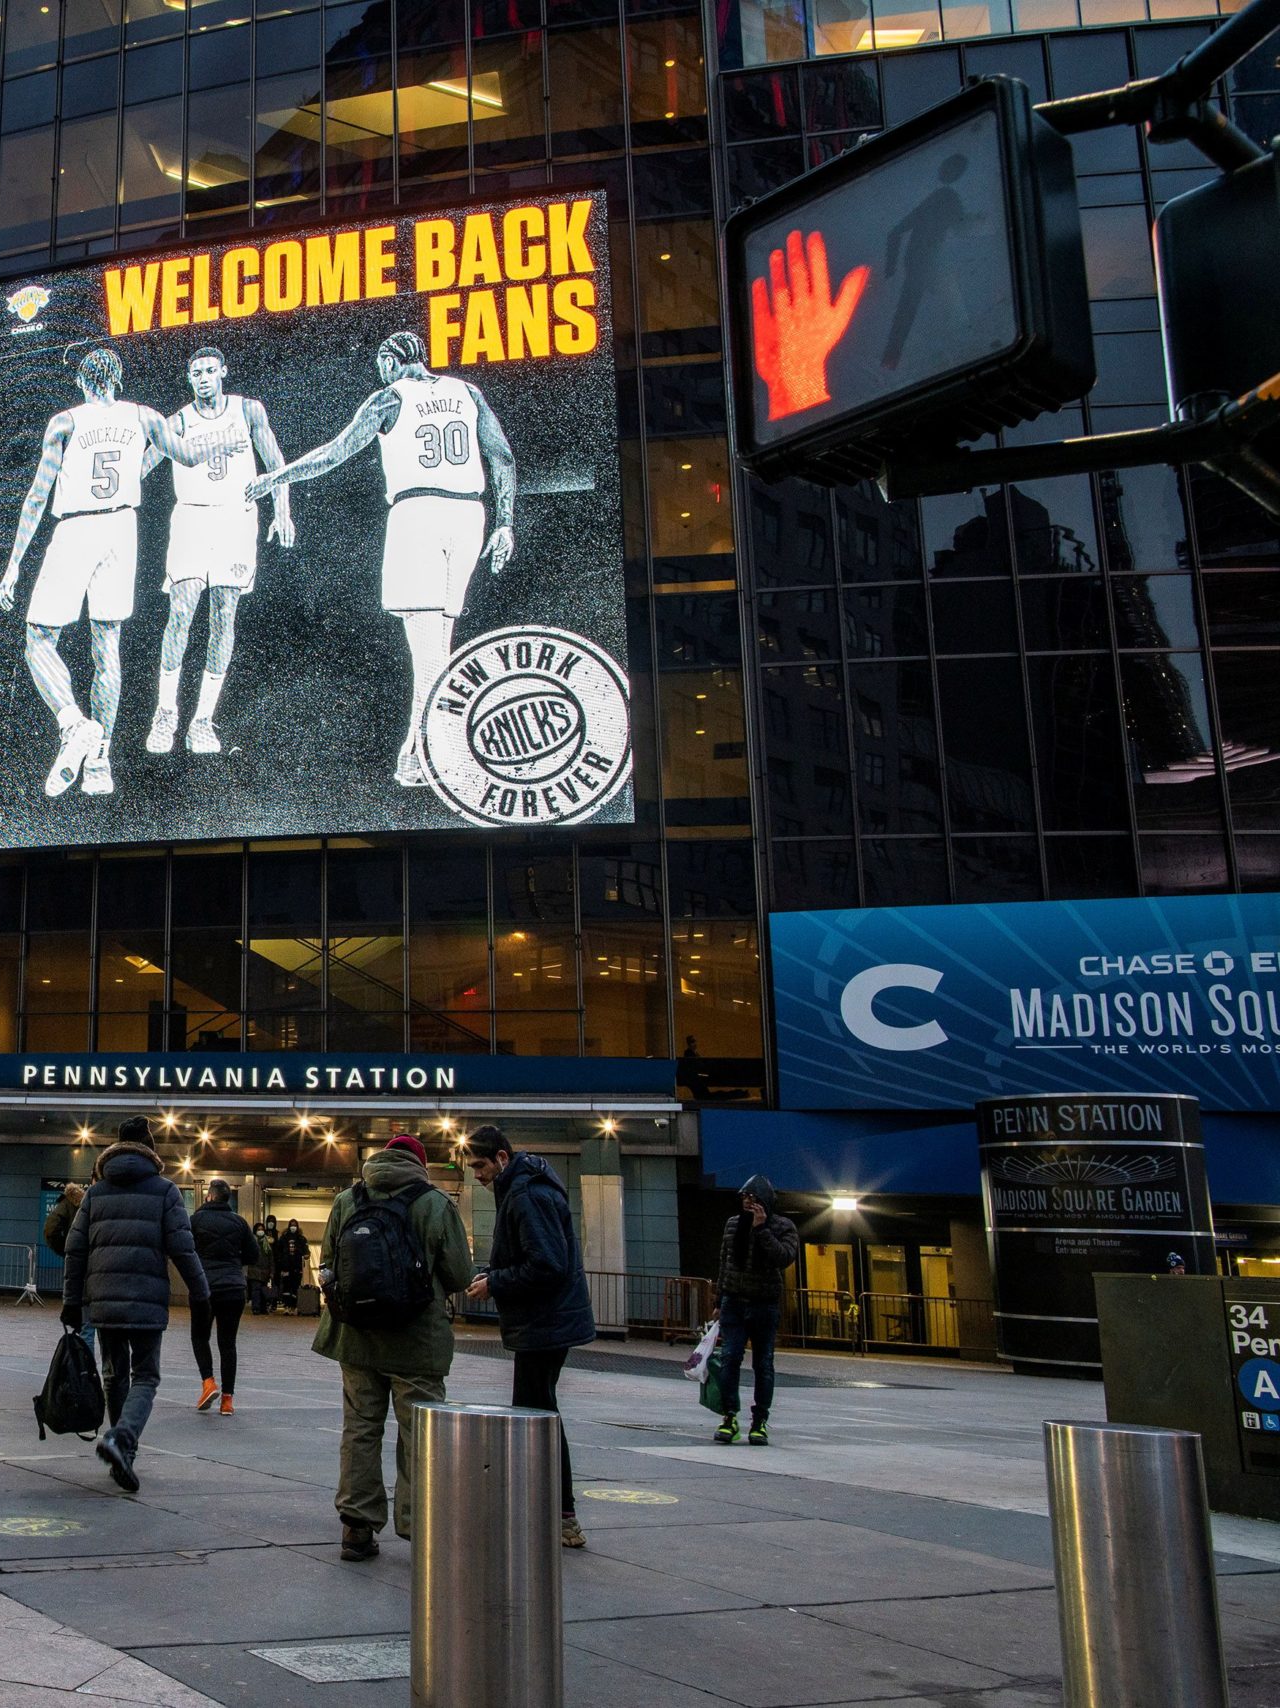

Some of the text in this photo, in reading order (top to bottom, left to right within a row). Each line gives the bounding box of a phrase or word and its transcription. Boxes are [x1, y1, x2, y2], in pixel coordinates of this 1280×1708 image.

[104, 199, 595, 336] WELCOME BACK
[429, 278, 597, 369] FANS
[415, 398, 463, 418] RANDLE
[78, 426, 137, 450] QUICKLEY
[414, 420, 470, 469] 30
[91, 450, 121, 500] 5
[436, 641, 583, 717] NEW YORK
[479, 700, 573, 758] KNICKS
[478, 749, 614, 818] FOREVER
[1079, 952, 1280, 976] CHASE E
[840, 963, 949, 1051] C
[1010, 987, 1194, 1038] MADISON
[1090, 1045, 1129, 1054] THE
[1137, 1044, 1232, 1054] WORLD'S
[23, 1065, 456, 1090] PENNSYLVANIA STATION
[993, 1103, 1163, 1135] PENN STATION
[993, 1186, 1183, 1213] MADISON SQUARE GARDEN
[1229, 1304, 1269, 1330] 34
[1253, 1370, 1280, 1399] A
